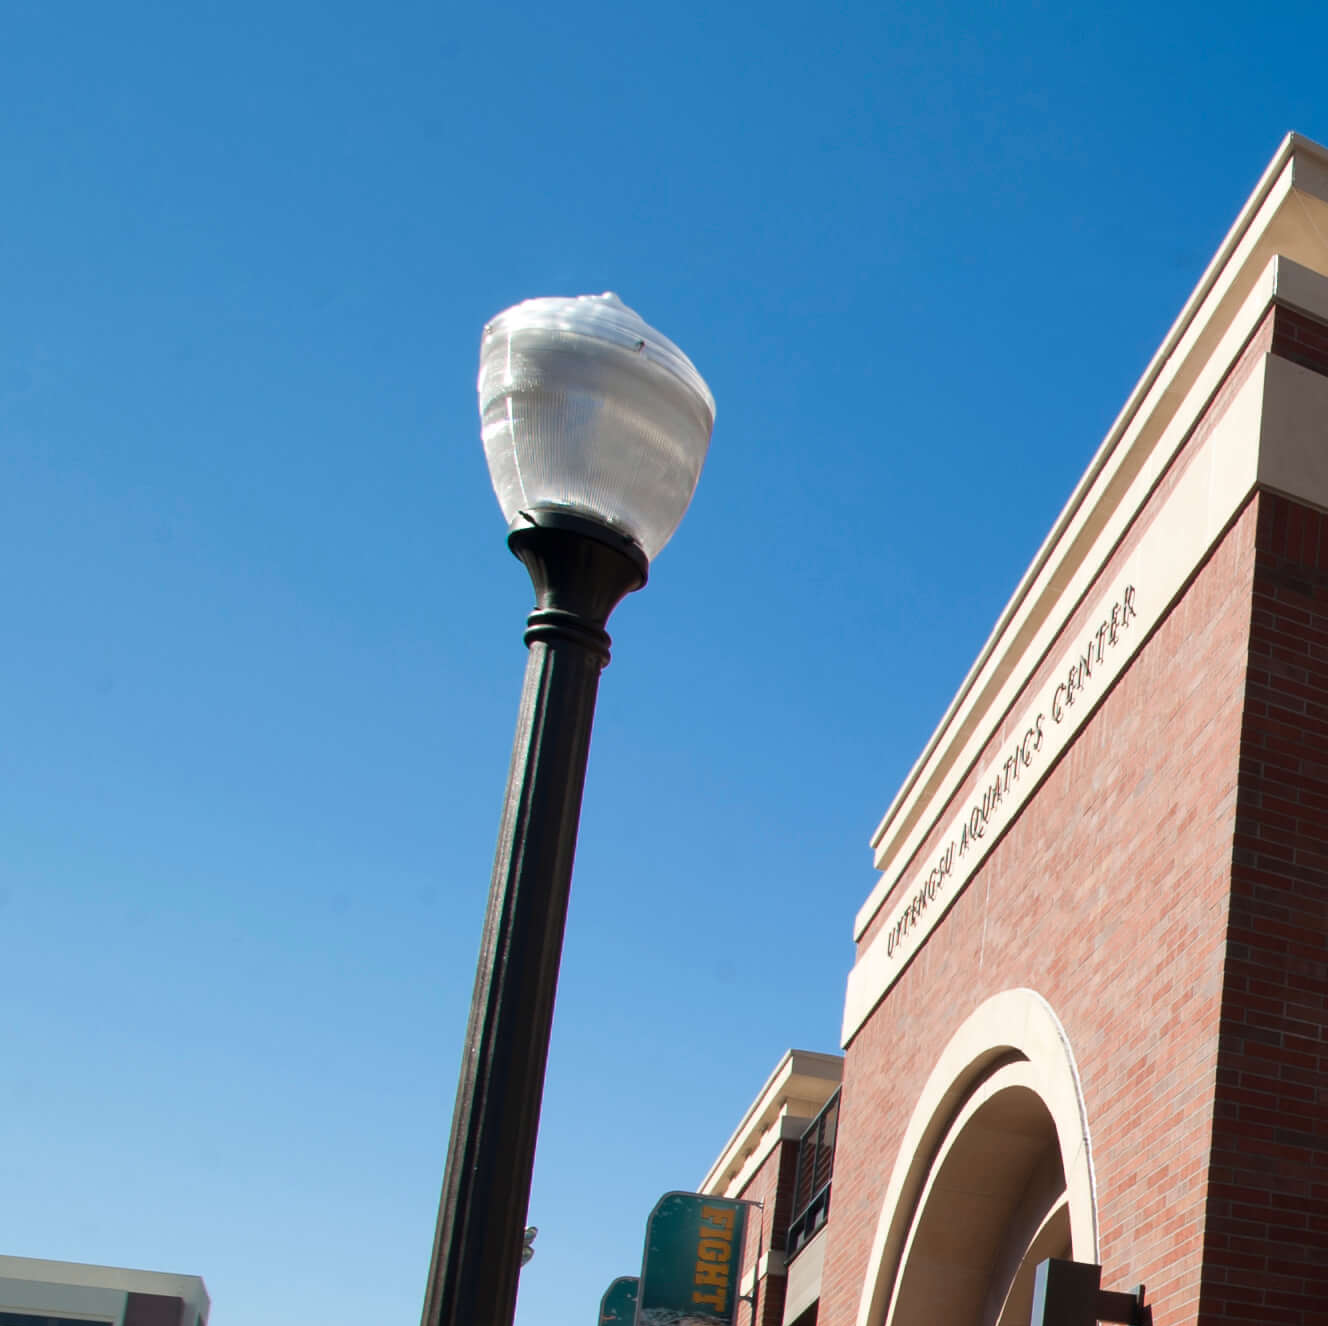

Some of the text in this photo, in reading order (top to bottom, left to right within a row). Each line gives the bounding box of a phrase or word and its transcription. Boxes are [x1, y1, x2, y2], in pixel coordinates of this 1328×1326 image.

[959, 712, 1045, 859] AQUATICS
[1052, 583, 1138, 724] CENTER
[692, 1205, 736, 1312] FIGHT
